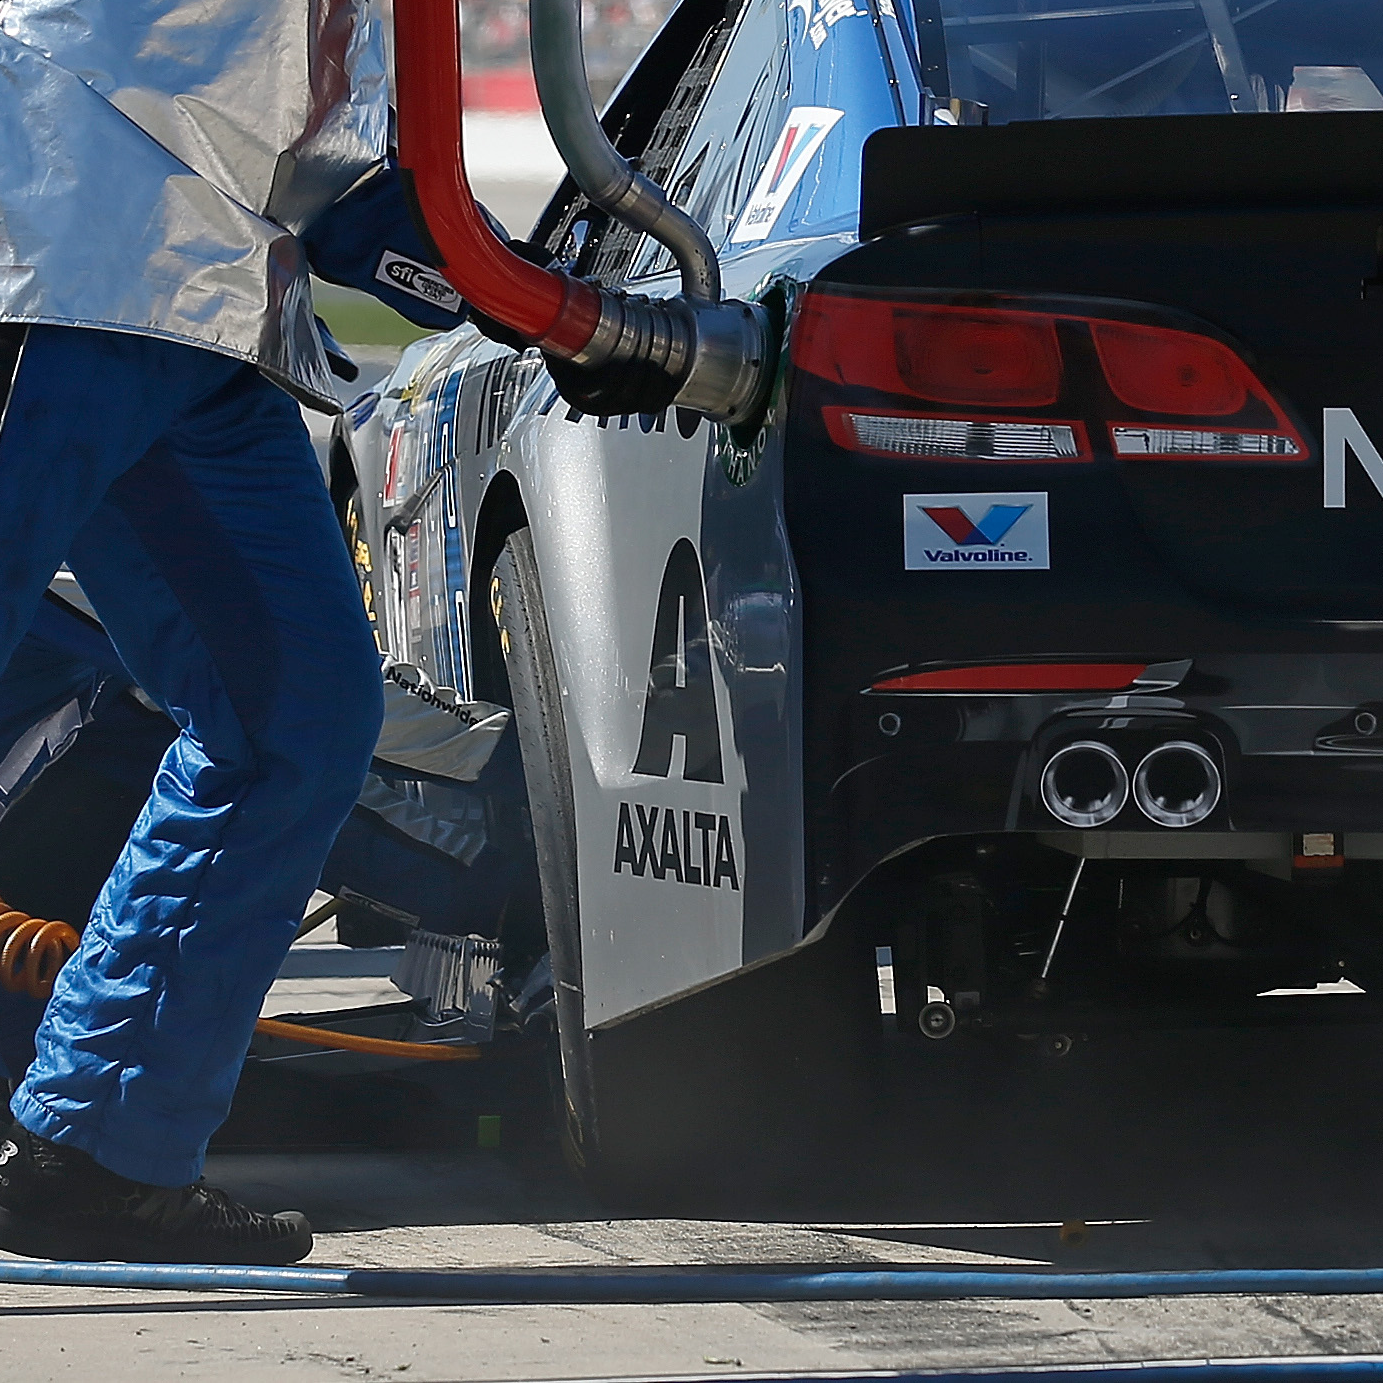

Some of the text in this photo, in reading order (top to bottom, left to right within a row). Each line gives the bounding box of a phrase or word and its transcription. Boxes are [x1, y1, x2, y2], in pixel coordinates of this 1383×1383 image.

[391, 265, 414, 283] sfi
[386, 665, 485, 728] Nationwide
[613, 800, 740, 892] AXALTA
